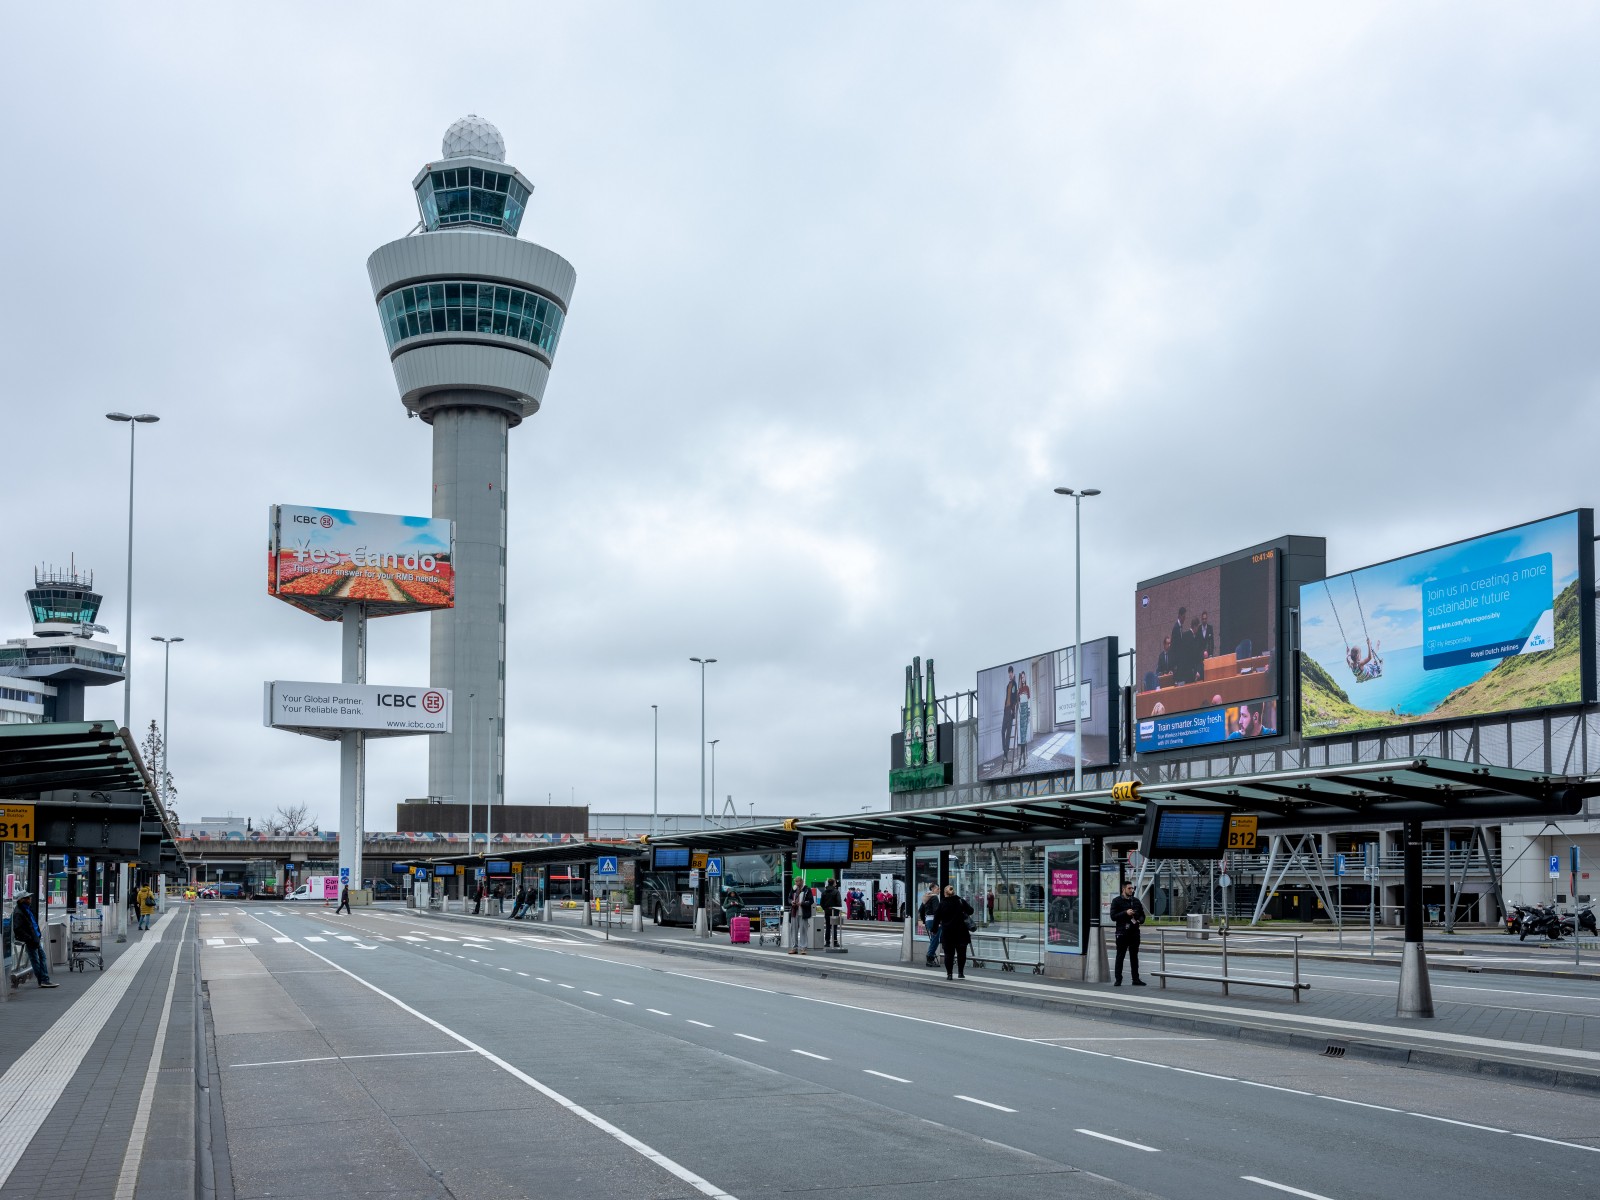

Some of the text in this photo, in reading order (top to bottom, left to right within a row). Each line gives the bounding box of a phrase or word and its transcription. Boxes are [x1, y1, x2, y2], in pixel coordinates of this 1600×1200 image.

[293, 515, 317, 525] ICBC
[403, 550, 440, 574] do.
[293, 564, 310, 573] This
[335, 569, 363, 577] answer
[364, 570, 375, 578] for
[377, 573, 395, 581] your
[396, 573, 414, 581] RMB
[416, 575, 440, 583] needs.
[1427, 564, 1547, 602] Join us in creating a more
[1427, 590, 1511, 617] sustainable future
[1530, 639, 1545, 647] KLM
[1470, 644, 1519, 659] Royal Dutch Airlines
[282, 694, 364, 705] Your Global Partner.
[377, 693, 416, 708] ICBC
[282, 704, 364, 715] Your Reliable Bank.
[386, 720, 444, 729] www.icbc.co.nl
[1157, 723, 1171, 732] Train
[1171, 719, 1194, 730] smarter.
[1194, 717, 1207, 727] Stay
[1113, 785, 1130, 799] B12
[1229, 832, 1255, 846] B12
[853, 850, 872, 860] B10
[1551, 857, 1557, 866] P
